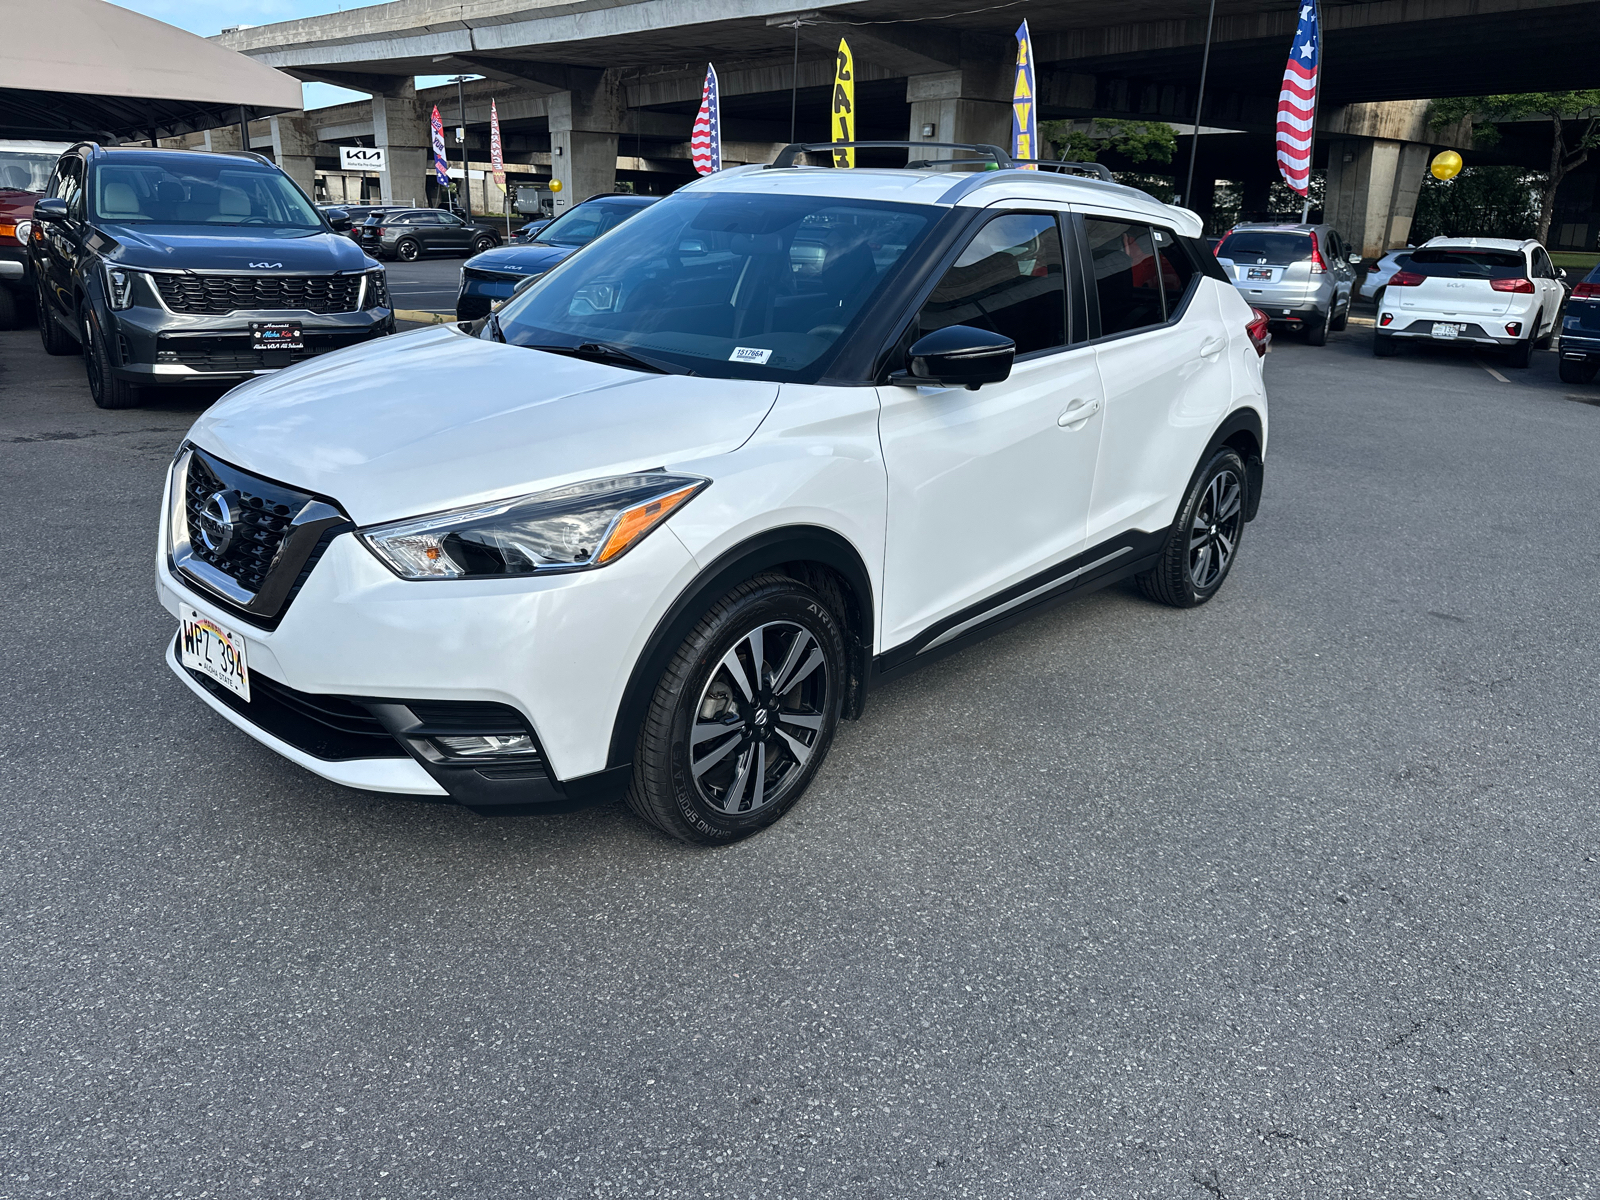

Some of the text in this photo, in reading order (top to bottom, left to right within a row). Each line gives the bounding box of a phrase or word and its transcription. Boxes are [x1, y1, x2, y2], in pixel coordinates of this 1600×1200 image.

[346, 150, 381, 160] KIA
[183, 619, 244, 685] WPZ 394
[203, 662, 234, 688] ALOHA STATE
[675, 785, 699, 823] SPORT
[696, 820, 732, 840] GRAND
